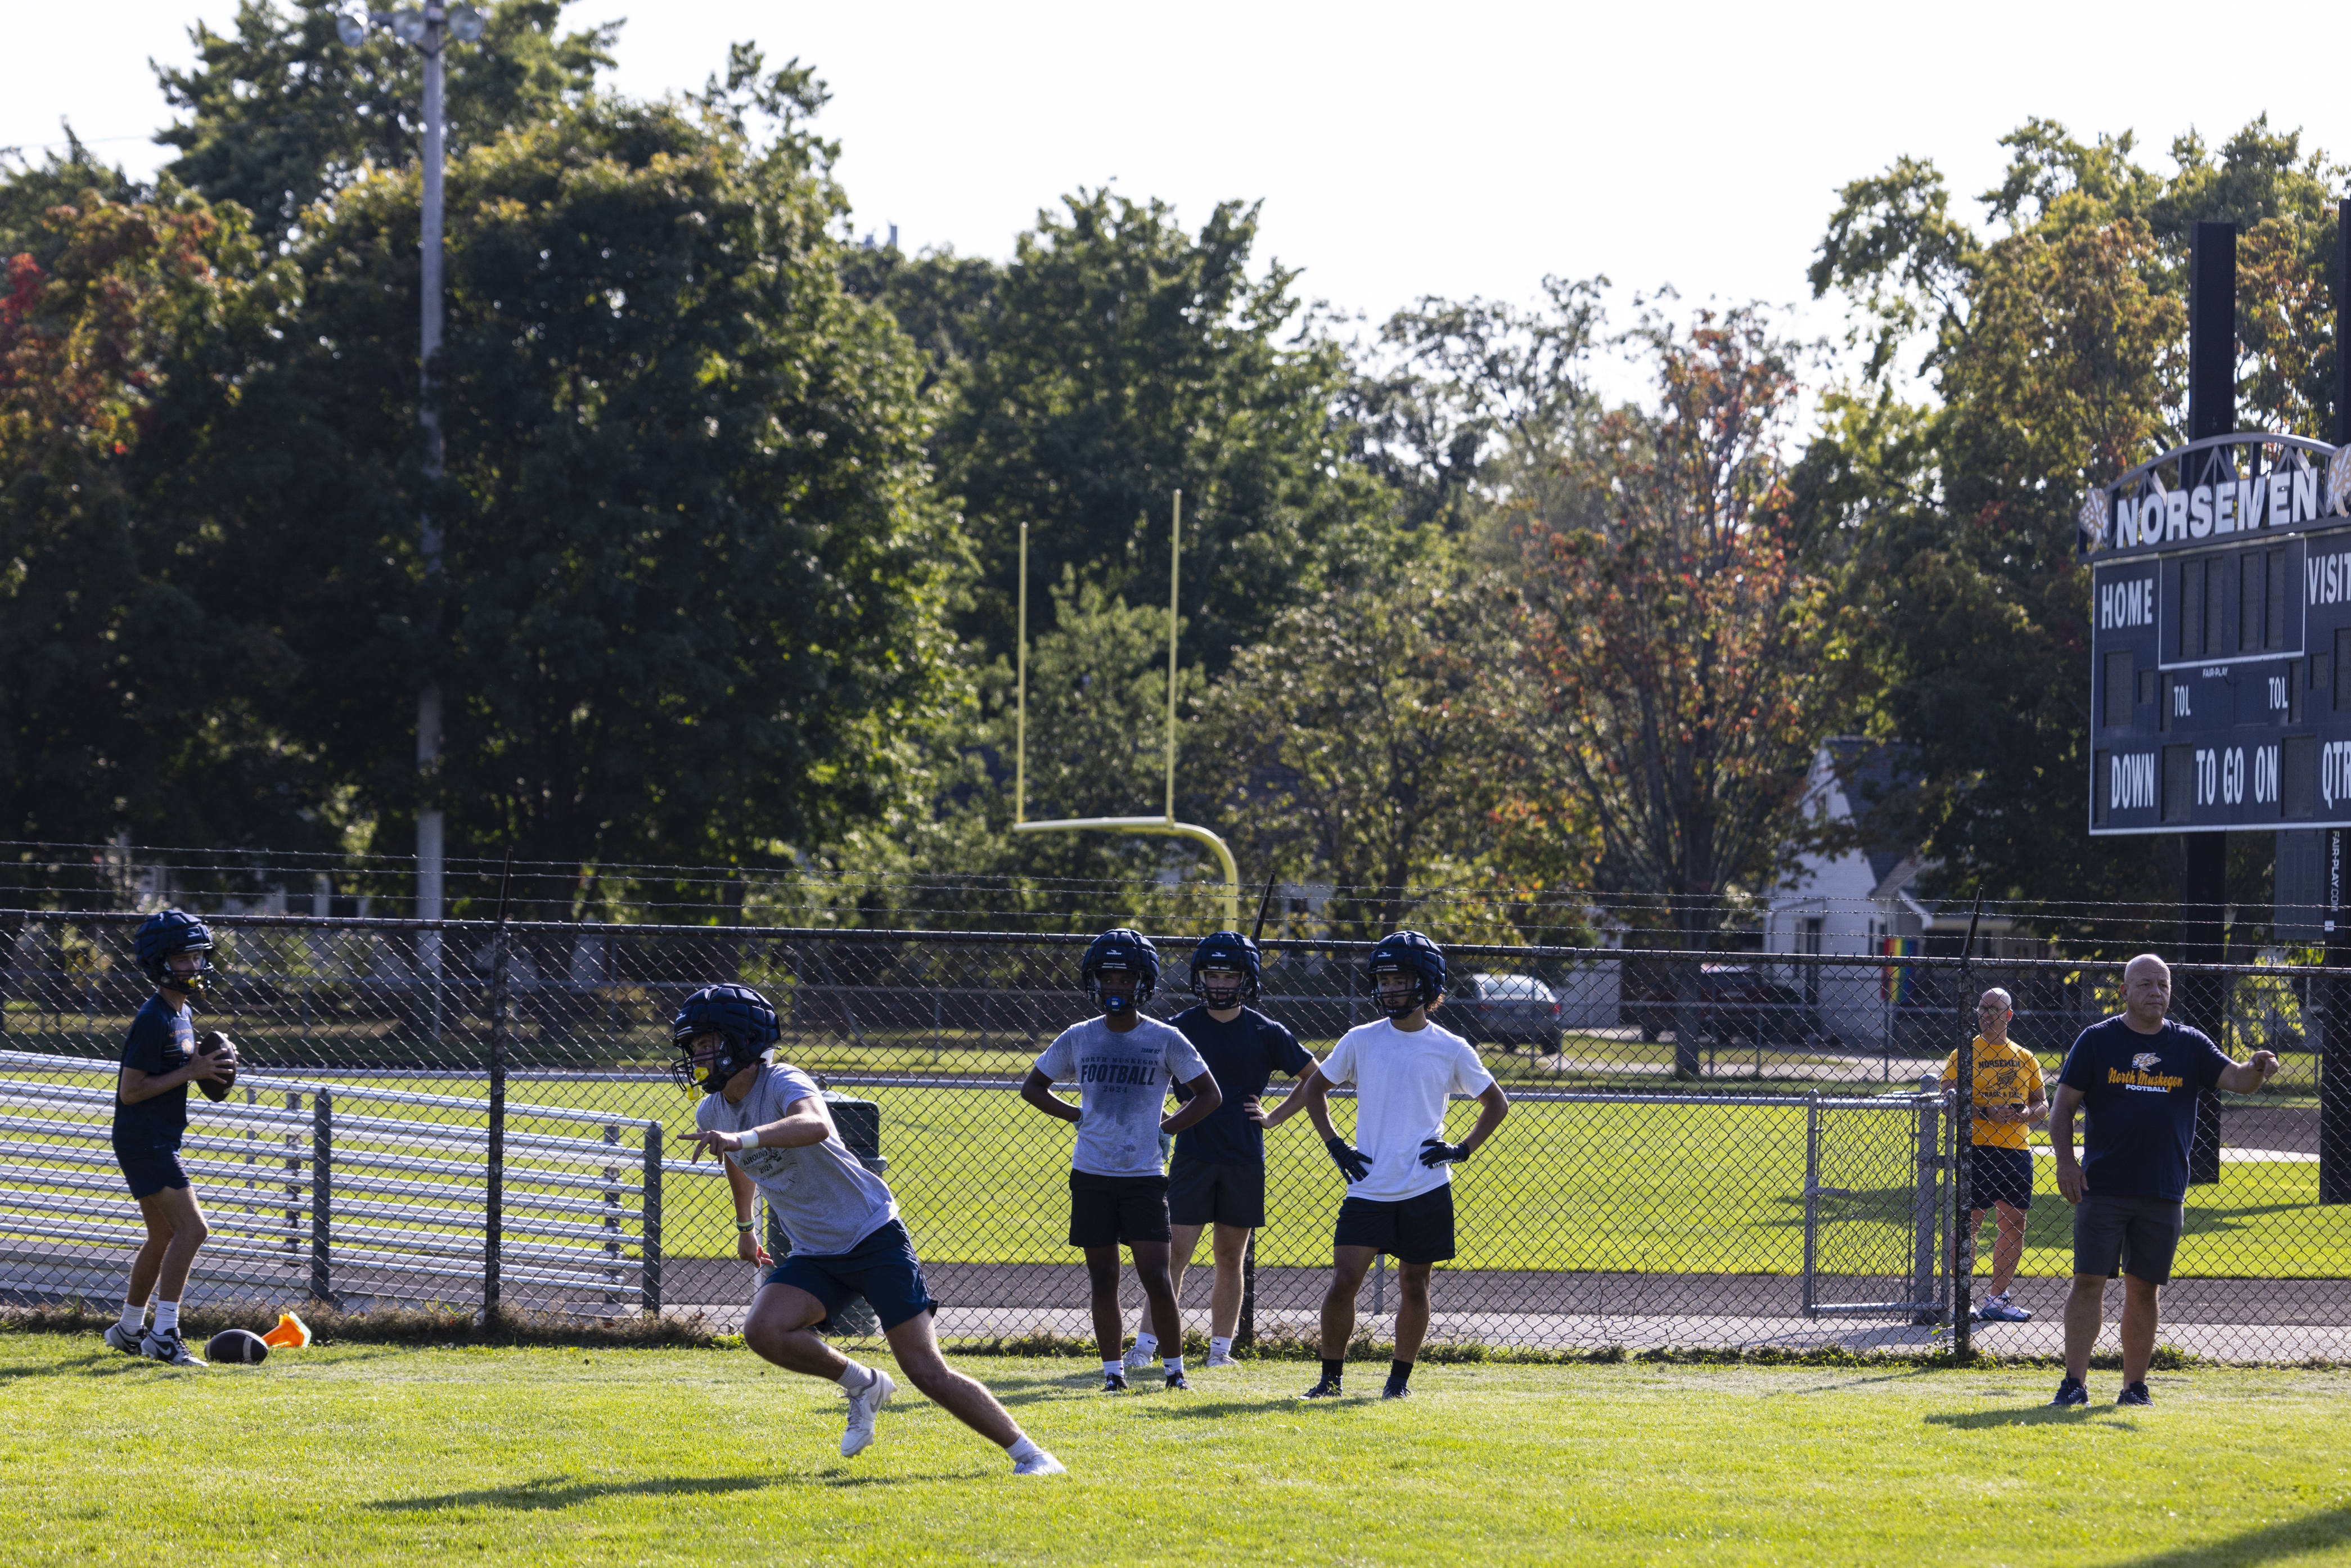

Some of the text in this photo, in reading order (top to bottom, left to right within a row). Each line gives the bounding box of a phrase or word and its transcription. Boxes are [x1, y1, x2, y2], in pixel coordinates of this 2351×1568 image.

[2116, 466, 2318, 549] NORSEMEN
[2101, 578, 2153, 630] HOME
[2203, 666, 2228, 678] FAIR-PLAY
[2174, 685, 2191, 717] TOL
[2269, 677, 2287, 710] TOL
[2111, 753, 2154, 809] DOWN
[2196, 746, 2244, 805] TO GO
[2255, 745, 2277, 804] ON
[1080, 1064, 1156, 1085] FOOTBALL
[1113, 1057, 1159, 1066] MUSKEGON
[2108, 1067, 2183, 1093] North Muskegon
[2125, 1084, 2168, 1092] FOOTBALL
[742, 1150, 768, 1166] AROUND
